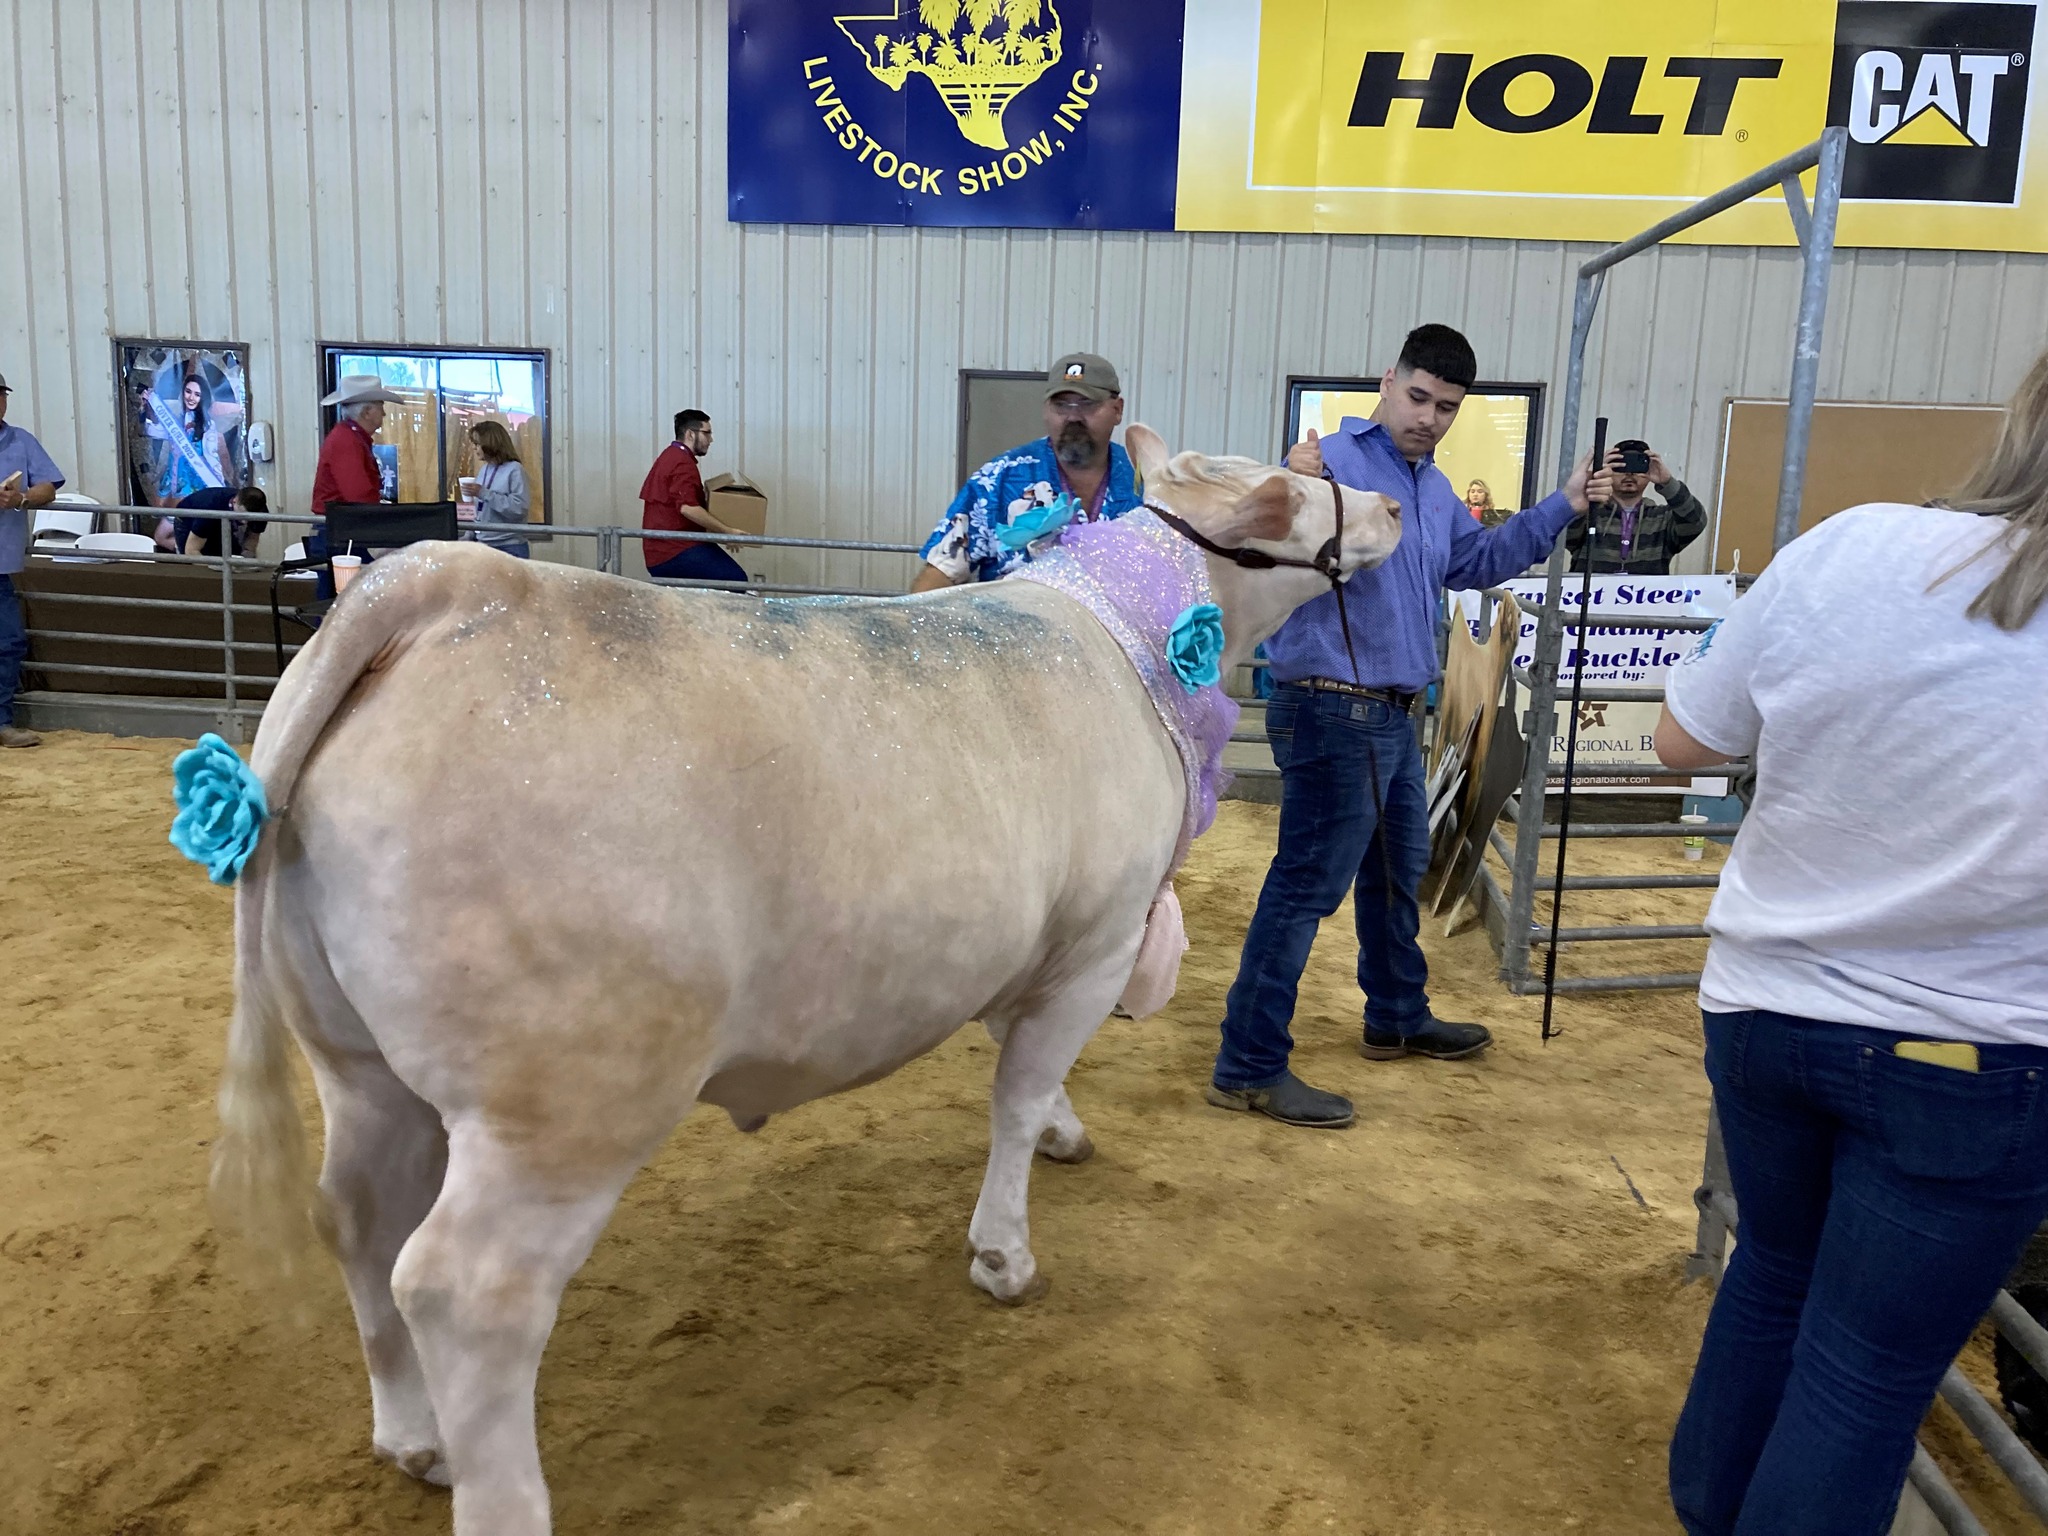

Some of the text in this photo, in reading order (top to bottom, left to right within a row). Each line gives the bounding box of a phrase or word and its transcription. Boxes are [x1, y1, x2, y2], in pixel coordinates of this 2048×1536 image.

[1347, 51, 1784, 136] HOLT
[1849, 50, 2009, 147] CAT
[802, 55, 1104, 196] LIVESTOCK SHOW, INC.
[155, 405, 174, 428] COVER
[170, 426, 185, 445] GIRL
[1614, 585, 1701, 605] Steer
[1565, 647, 1681, 668] Buckle
[1622, 670, 1645, 681] by:
[1552, 736, 1633, 752] RGIONAL
